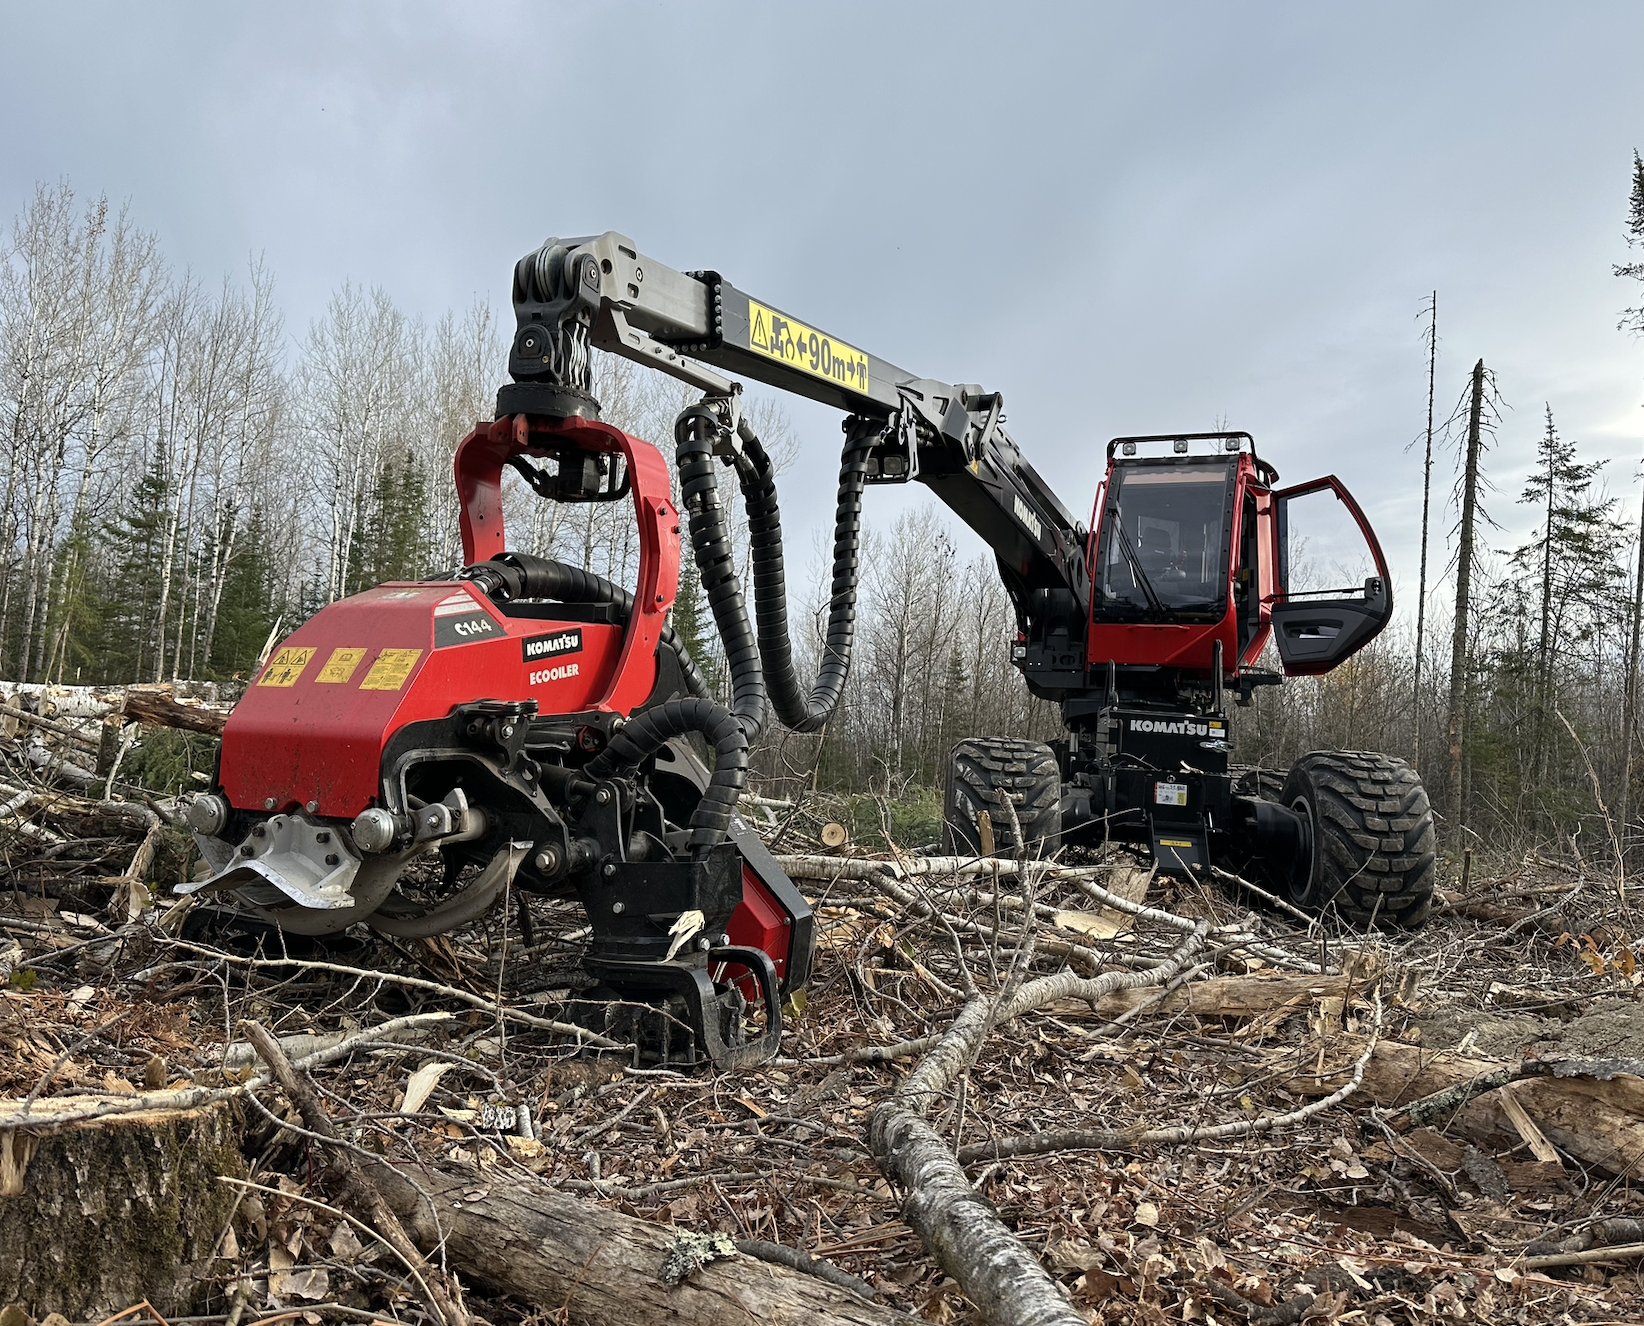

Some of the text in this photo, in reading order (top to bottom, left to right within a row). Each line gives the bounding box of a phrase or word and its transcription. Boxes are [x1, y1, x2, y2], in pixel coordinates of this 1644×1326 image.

[455, 619, 492, 636] C144
[527, 634, 578, 656] KOMATSU
[529, 664, 579, 685] ECOOILER
[1130, 720, 1208, 736] KOMATSU
